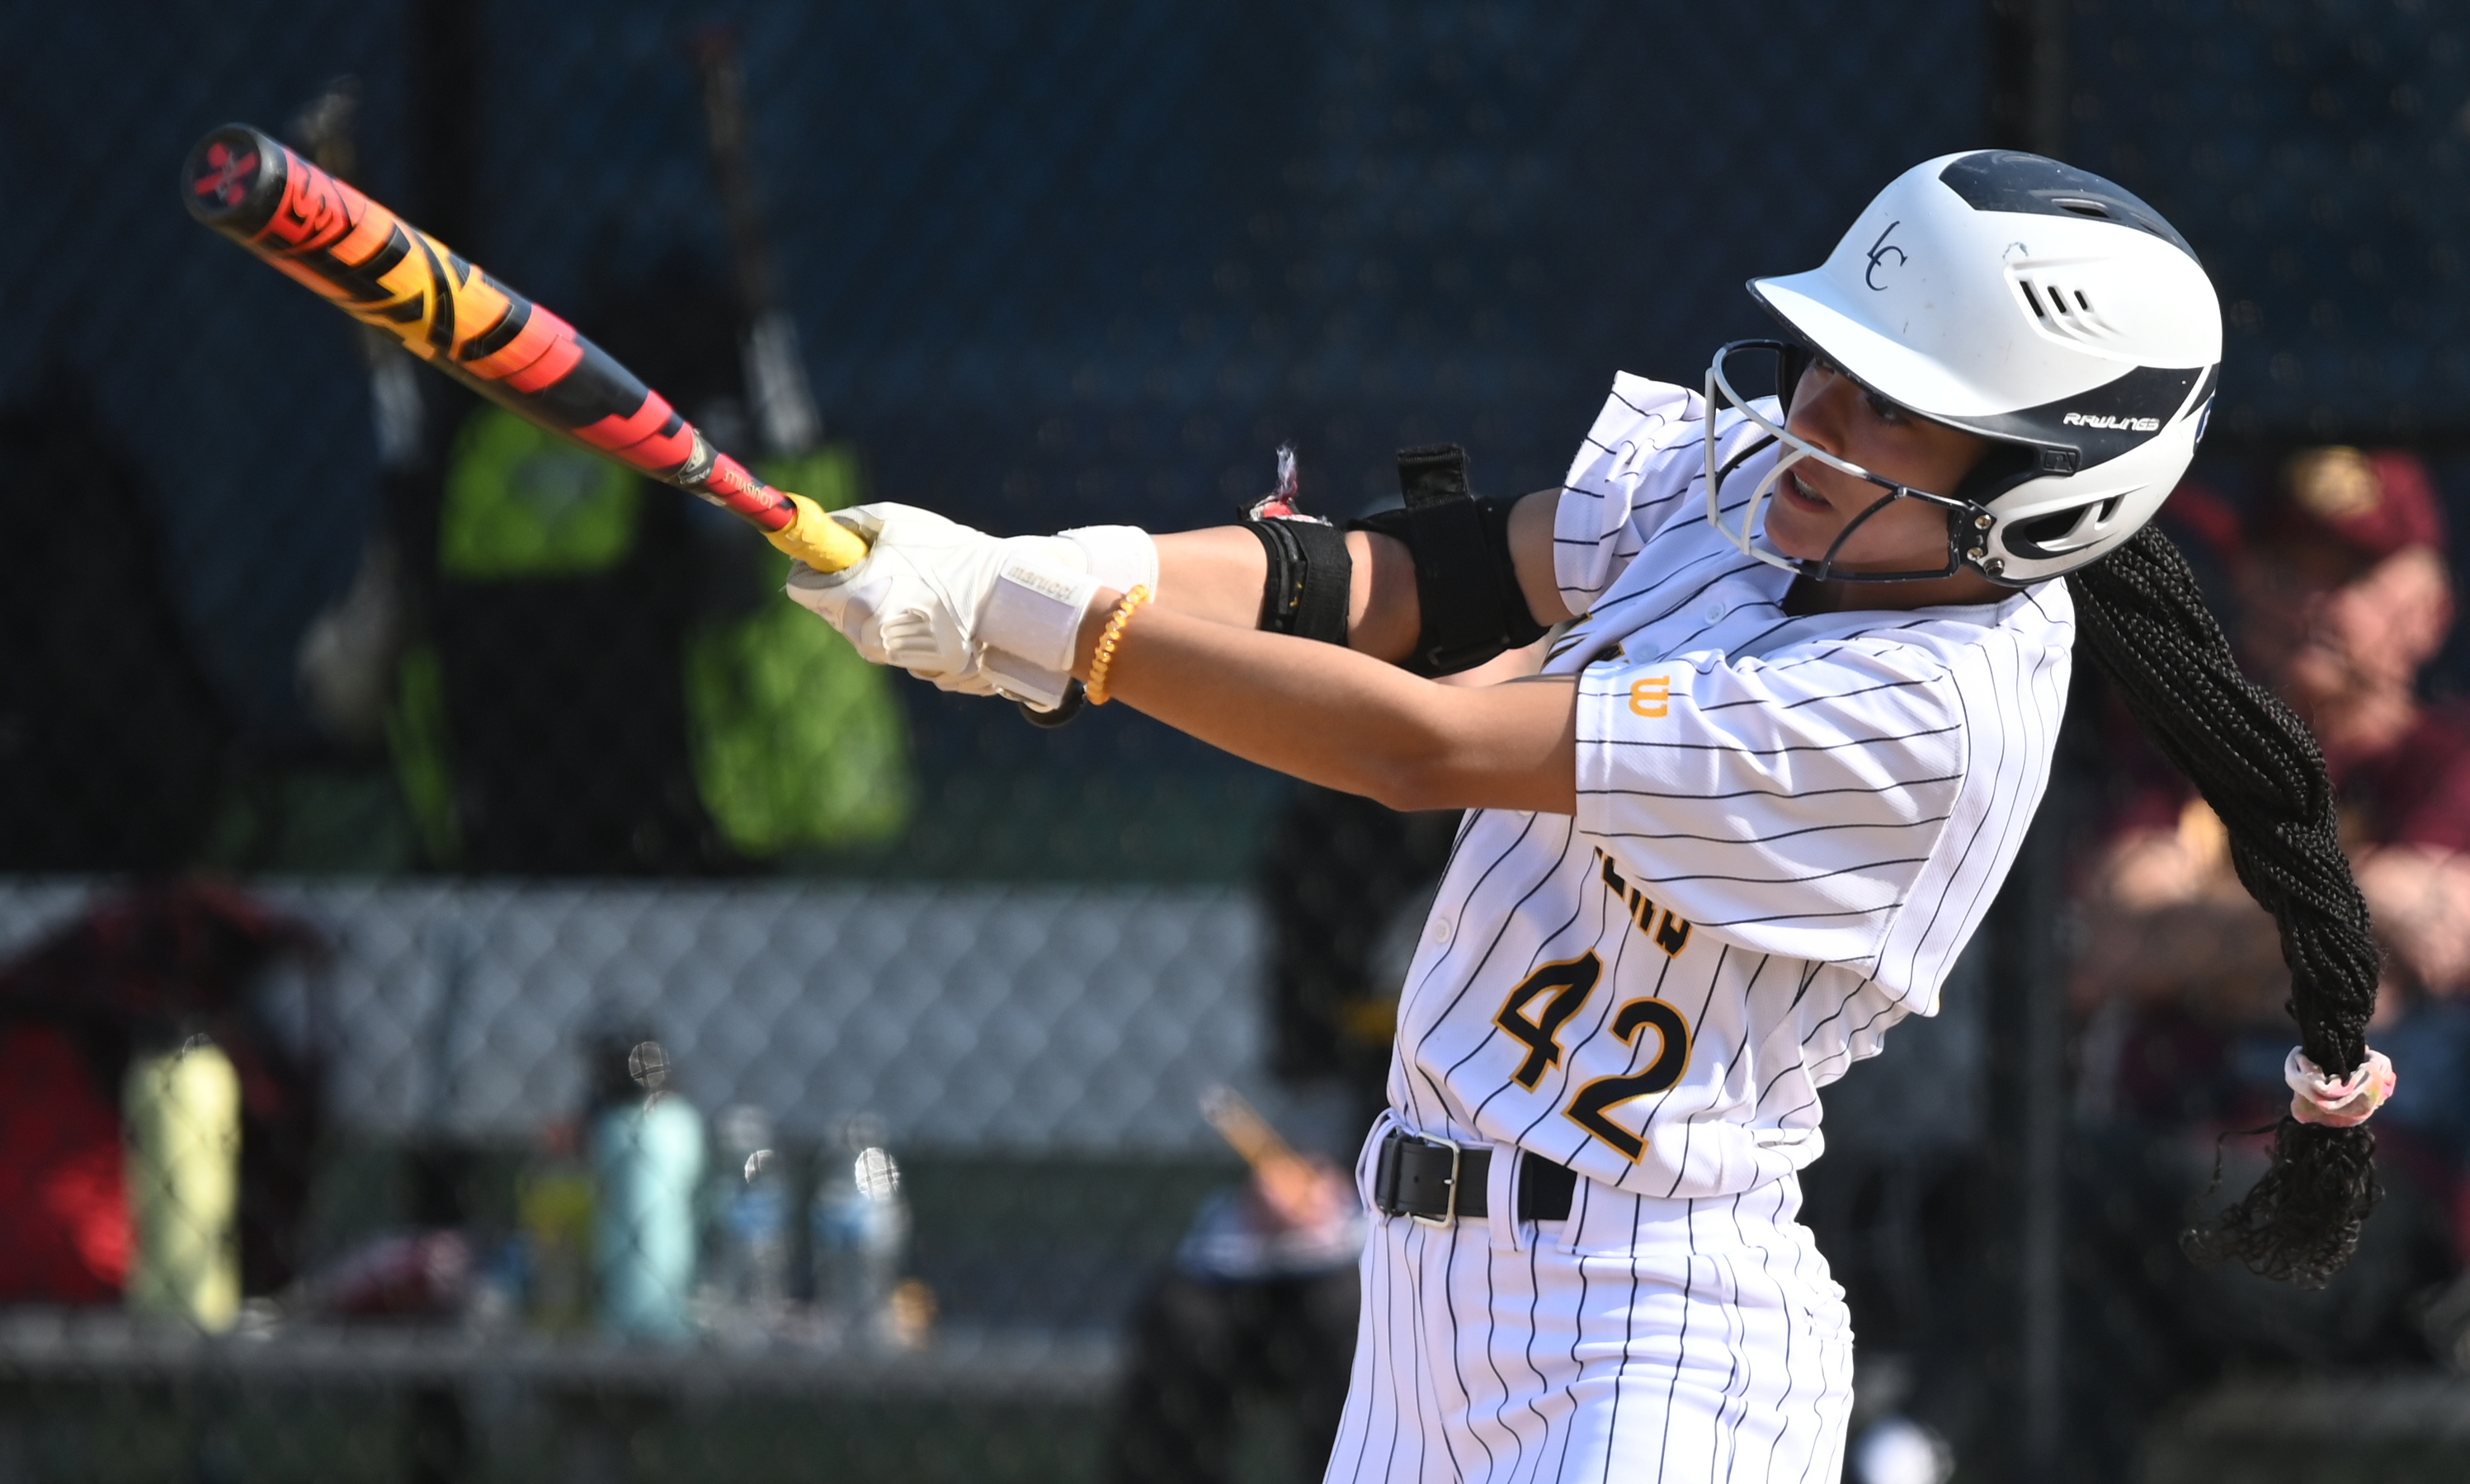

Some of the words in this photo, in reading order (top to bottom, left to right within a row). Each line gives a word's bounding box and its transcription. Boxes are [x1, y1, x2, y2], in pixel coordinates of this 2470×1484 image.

[1865, 220, 1907, 291] LC
[2063, 412, 2161, 431] RAWLINGS
[724, 466, 774, 510] LOUISVILLE
[1492, 945, 1693, 1164] 42
